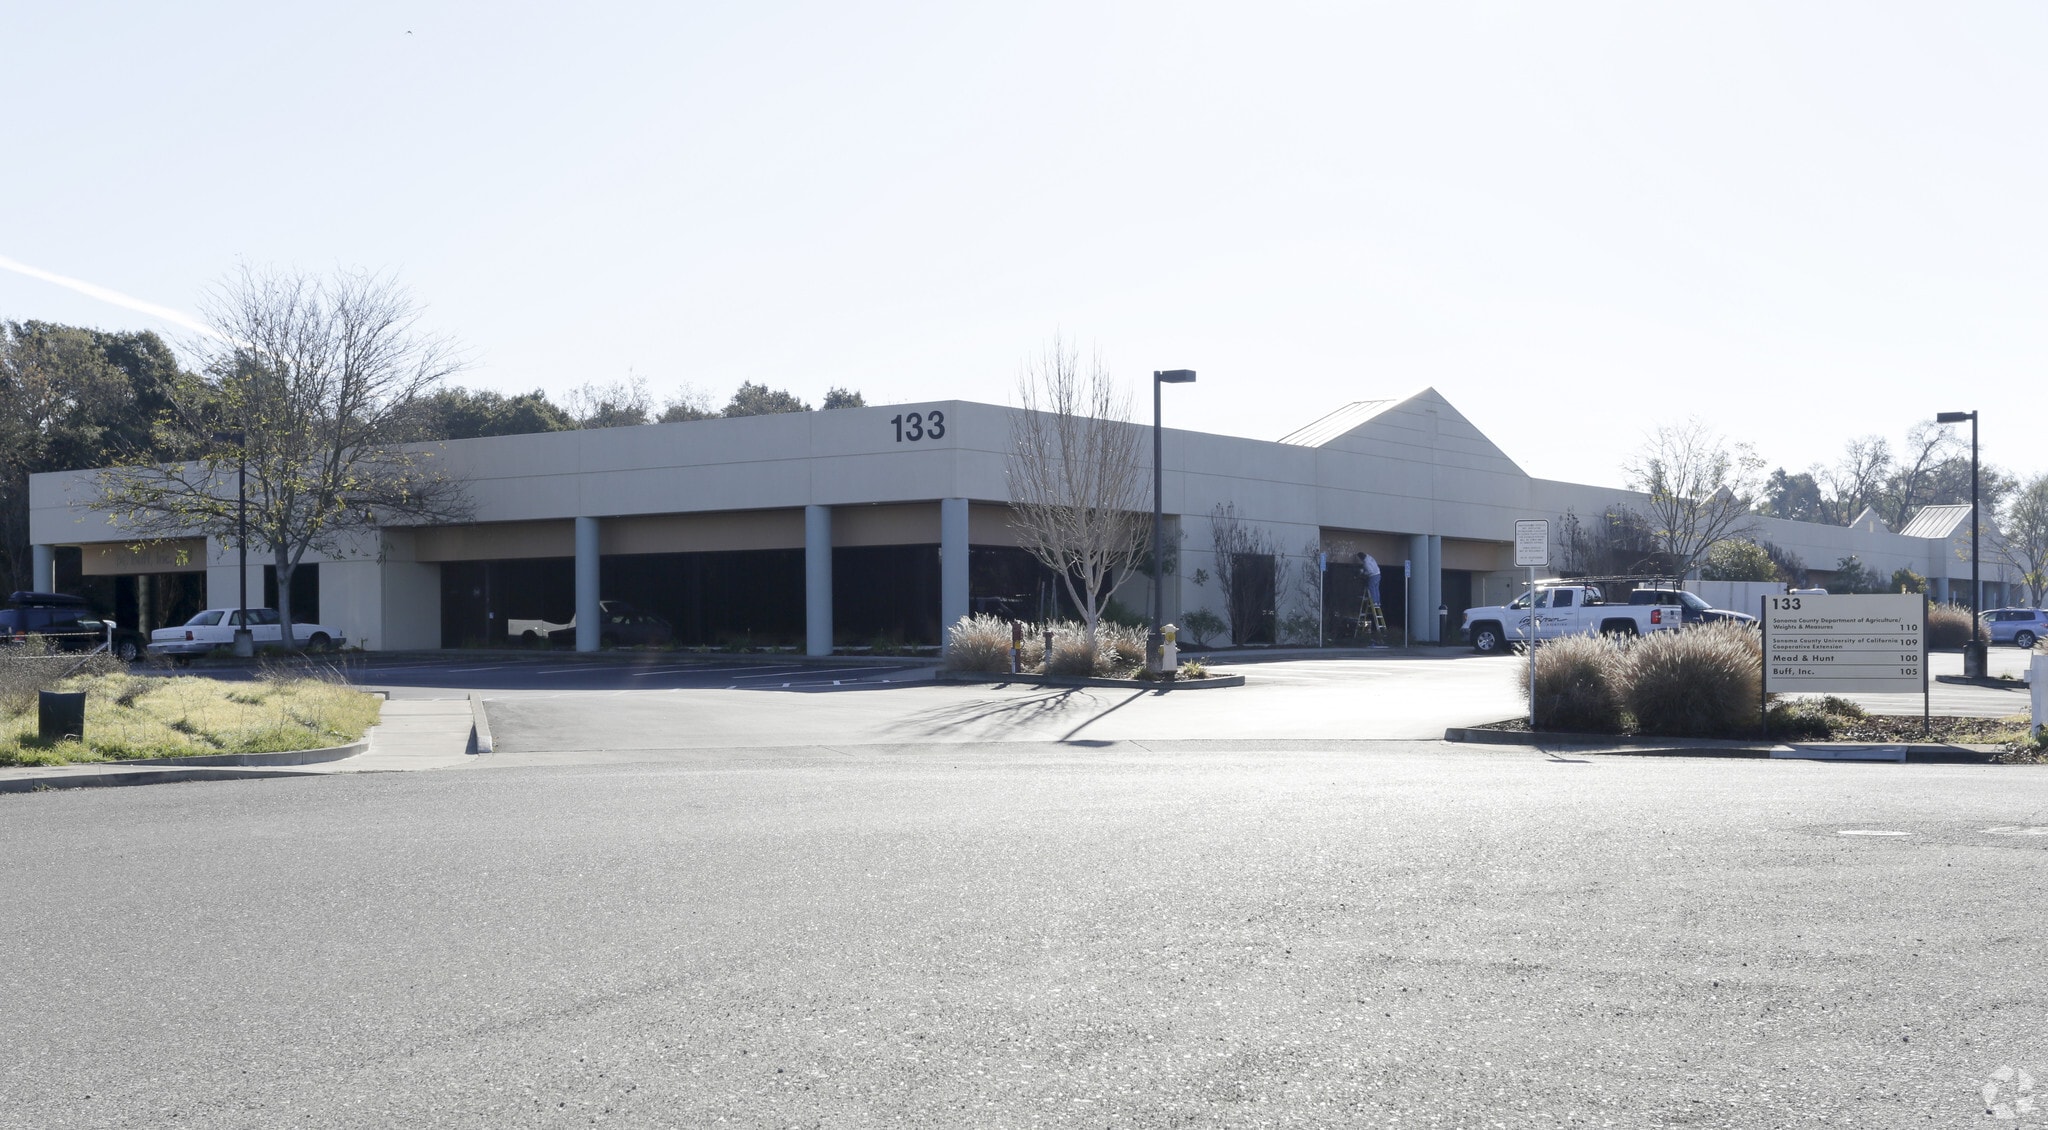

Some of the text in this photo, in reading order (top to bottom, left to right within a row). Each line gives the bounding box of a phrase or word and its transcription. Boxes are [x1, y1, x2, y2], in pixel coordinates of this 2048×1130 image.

[890, 410, 946, 443] 133
[1772, 597, 1801, 610] 133
[1799, 617, 1820, 625] County
[1821, 617, 1857, 625] Department
[1865, 616, 1902, 625] Agriculture/
[1900, 624, 1918, 632] 110
[1824, 637, 1856, 645] University
[1900, 638, 1918, 646] 109
[1773, 668, 1795, 676] Buff,
